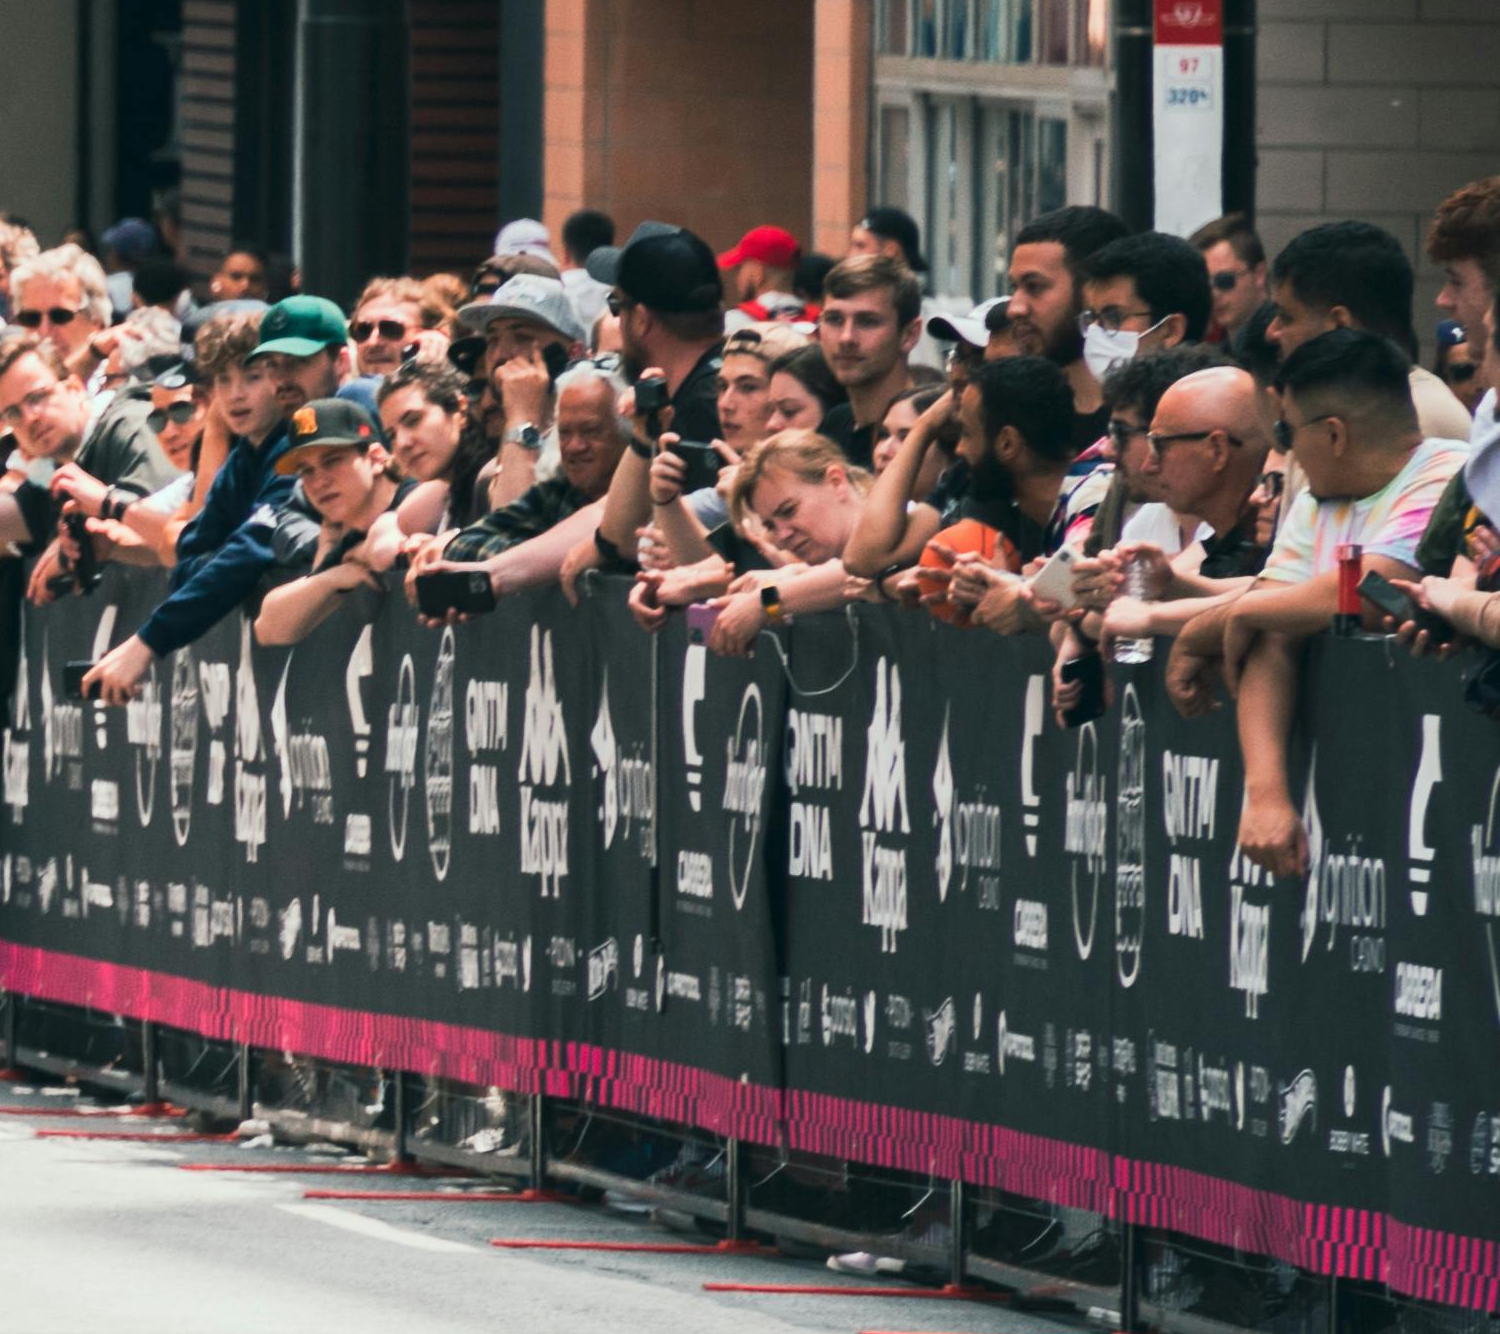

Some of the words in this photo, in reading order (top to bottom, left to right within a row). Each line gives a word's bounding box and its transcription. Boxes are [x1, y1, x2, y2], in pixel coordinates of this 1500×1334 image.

[1179, 58, 1200, 75] 97
[465, 678, 508, 758] QNTM
[784, 708, 843, 795] QNTM
[469, 764, 501, 835] DNA
[1163, 750, 1219, 846] QNTM
[519, 786, 570, 899] Kappa
[789, 804, 833, 881] DNA
[1168, 854, 1205, 939] DNA
[1320, 832, 1387, 952] Ignition
